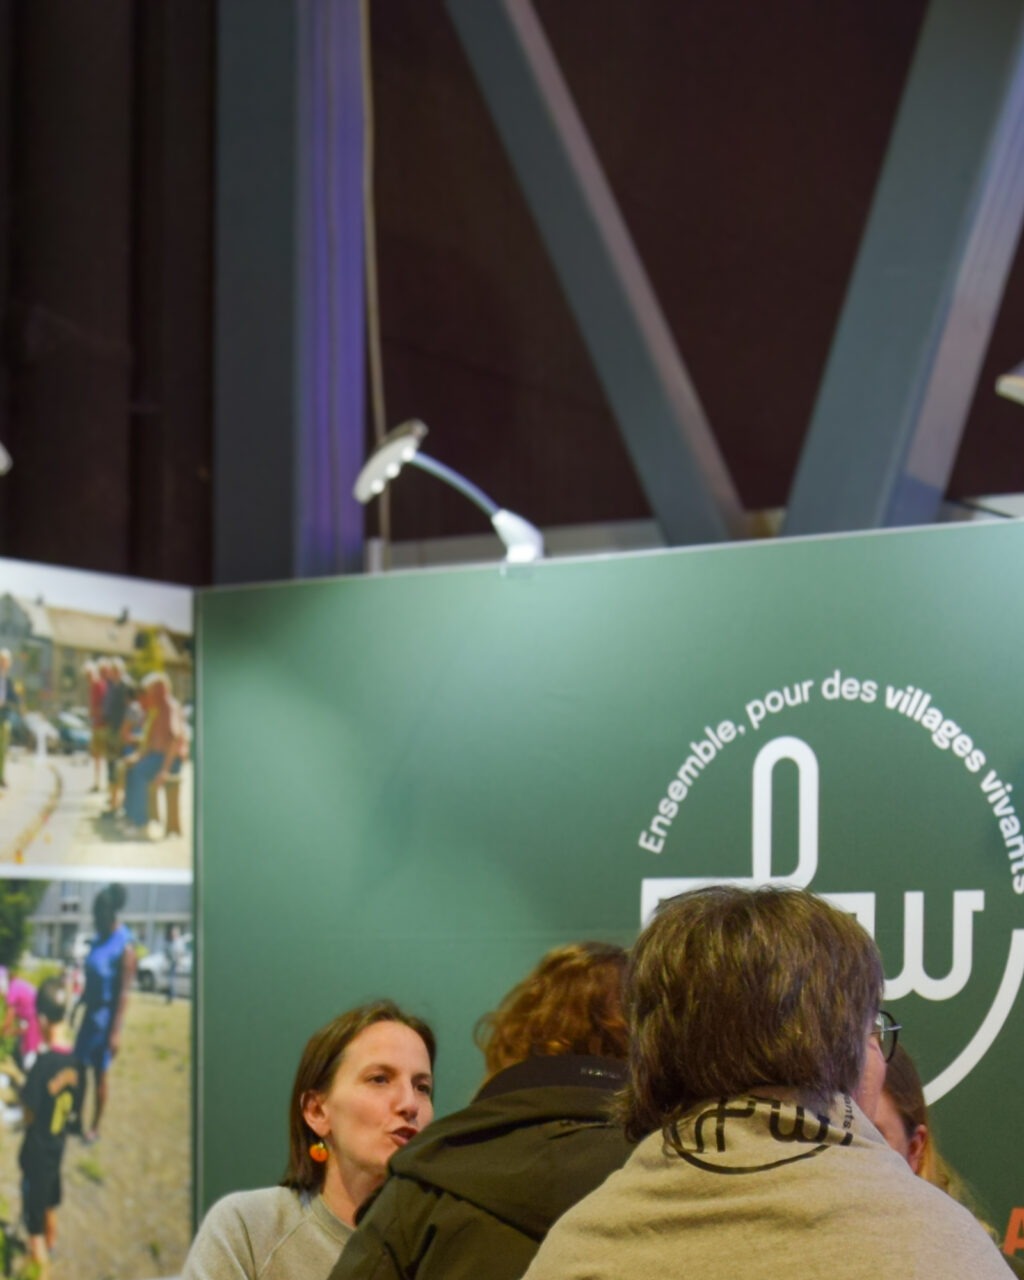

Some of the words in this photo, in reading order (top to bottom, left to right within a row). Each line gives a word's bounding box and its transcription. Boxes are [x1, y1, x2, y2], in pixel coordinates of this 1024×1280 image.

[639, 718, 747, 855] Ensemble,
[744, 679, 815, 730] pour
[821, 669, 879, 702] des
[884, 684, 987, 774] villages
